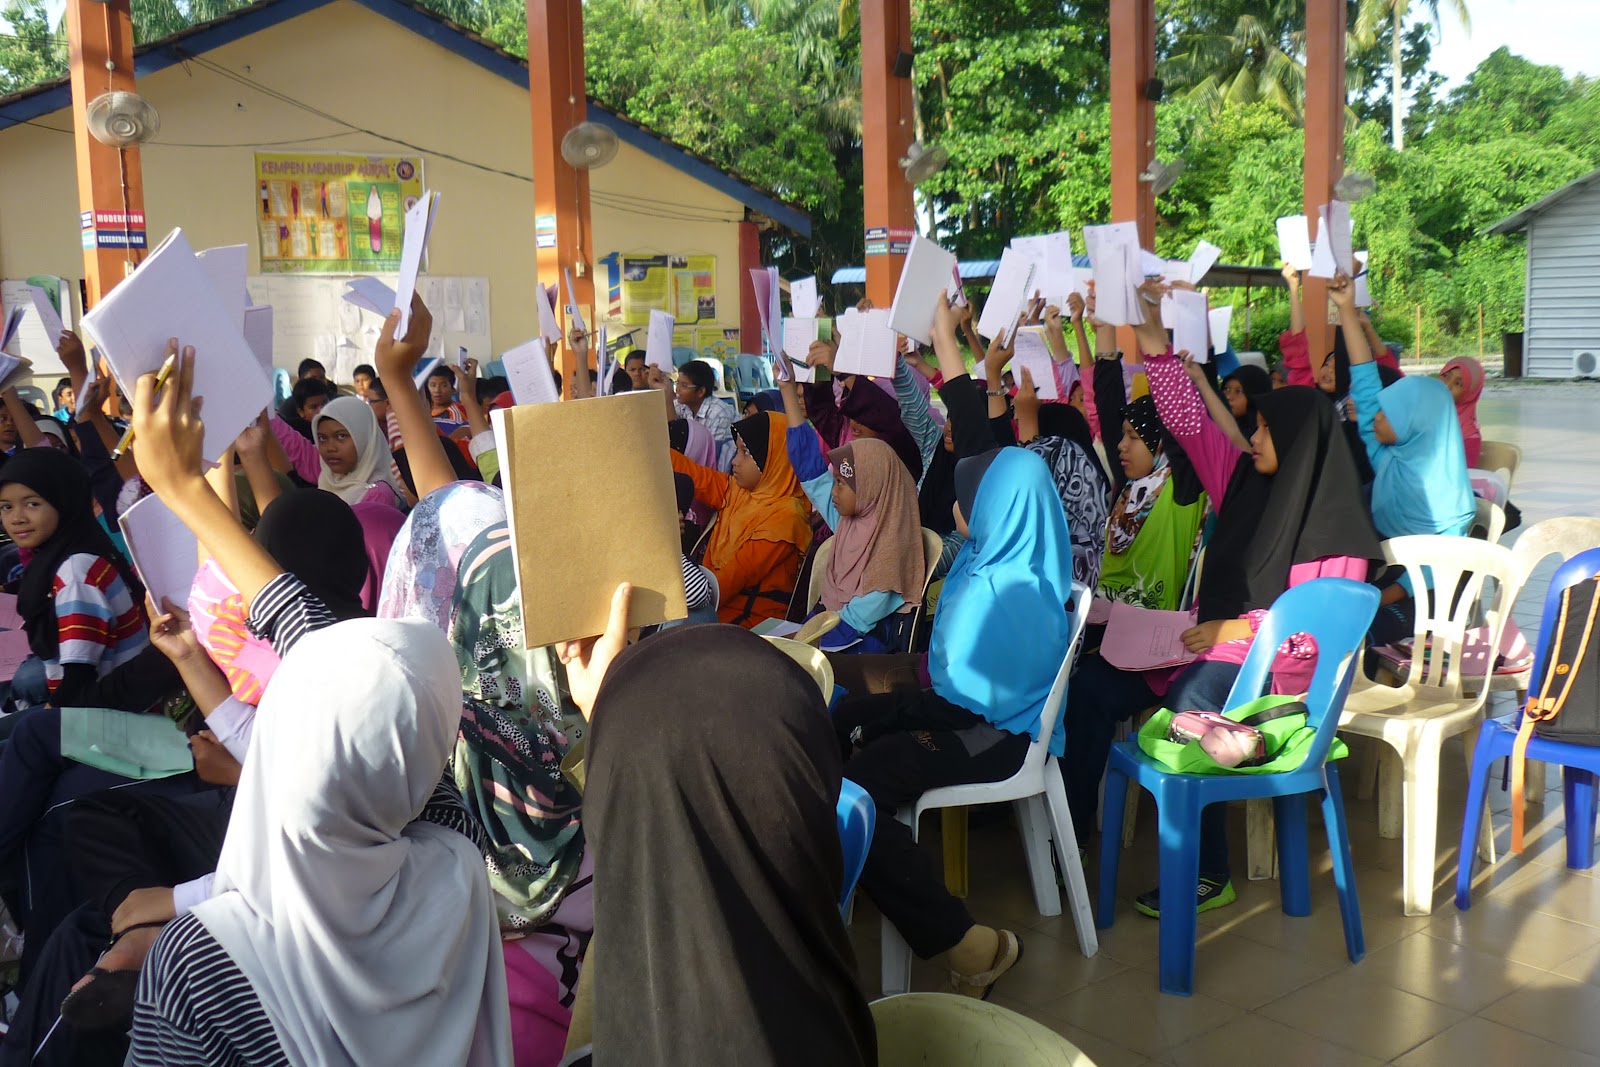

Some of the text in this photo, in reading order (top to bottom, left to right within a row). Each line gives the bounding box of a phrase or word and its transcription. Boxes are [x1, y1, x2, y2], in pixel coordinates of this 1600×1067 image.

[261, 160, 304, 174] KEMPEN
[306, 161, 354, 176] MENUTUP
[97, 214, 143, 223] MODERATION
